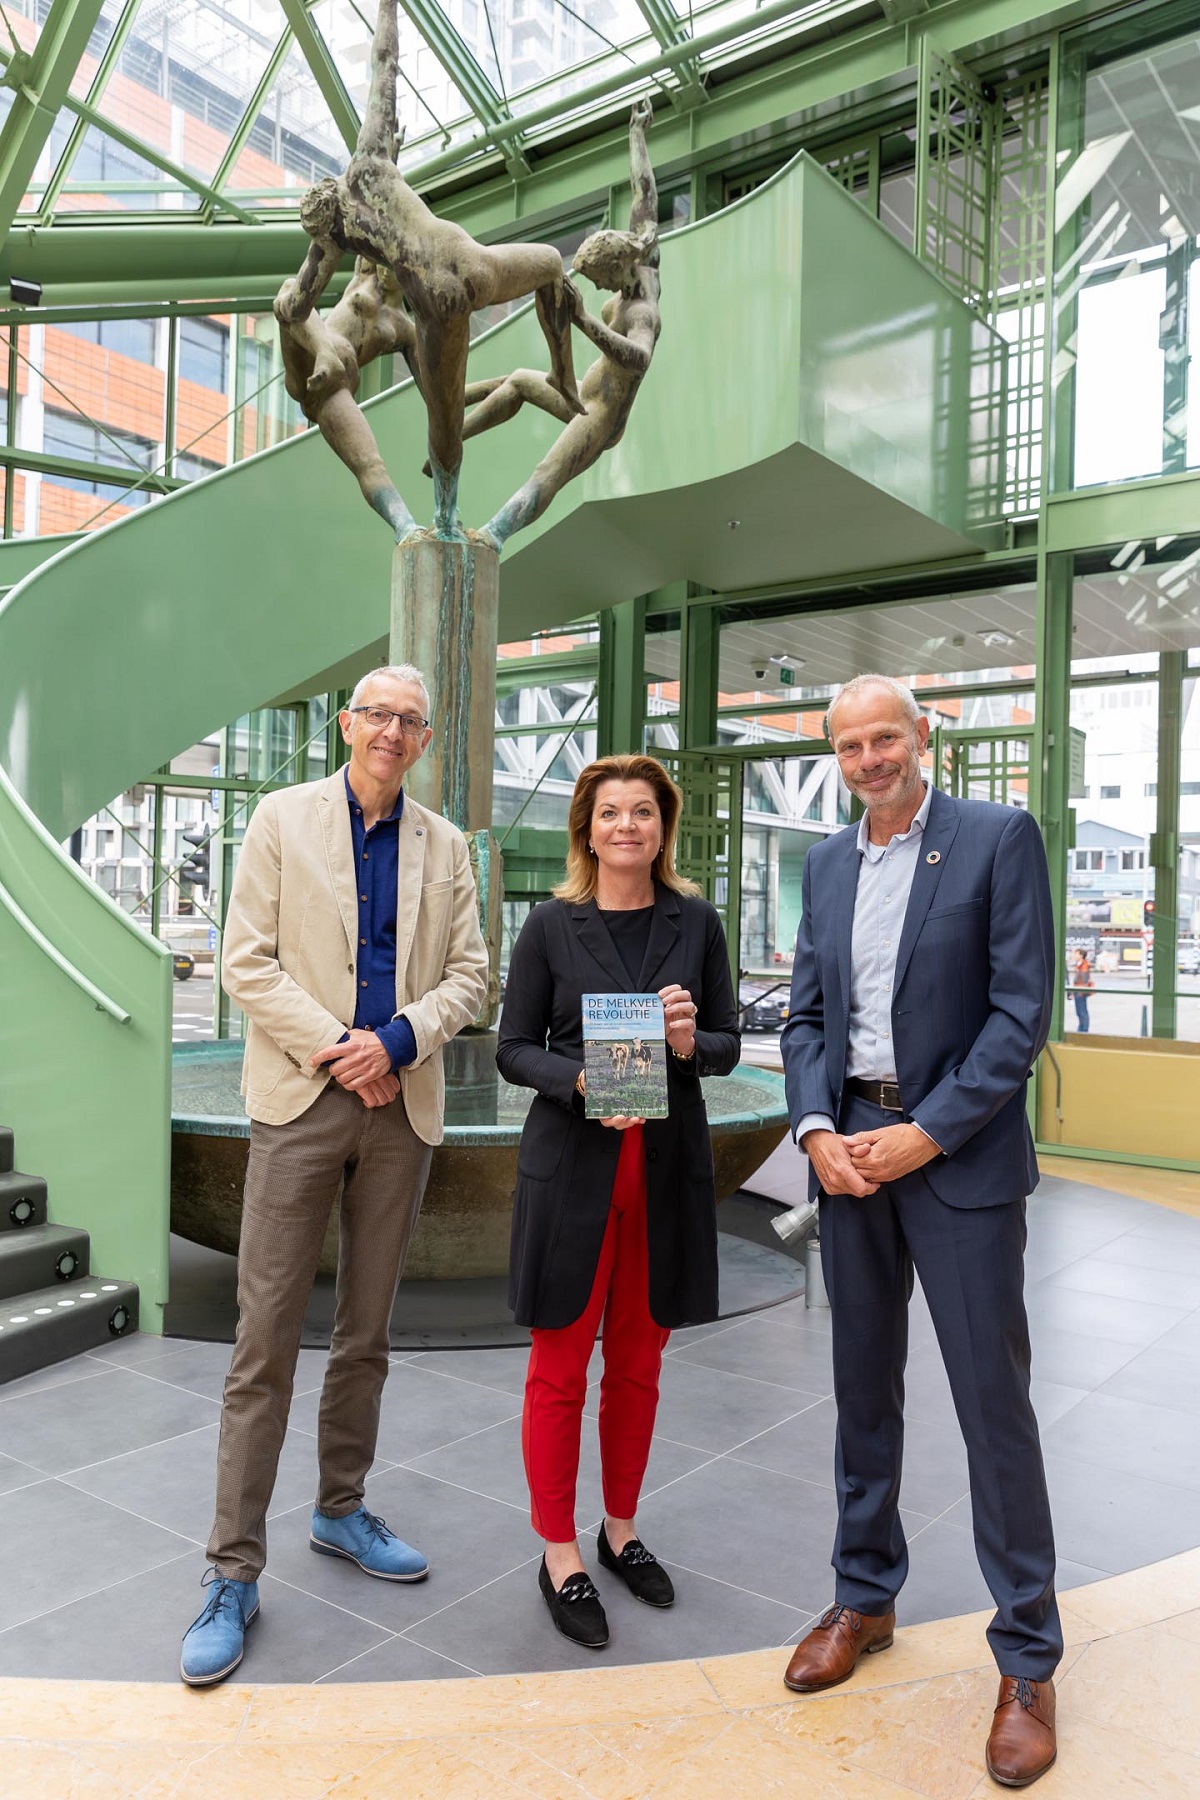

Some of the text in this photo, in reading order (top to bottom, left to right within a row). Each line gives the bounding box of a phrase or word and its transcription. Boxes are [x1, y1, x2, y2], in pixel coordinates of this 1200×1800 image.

[588, 998, 658, 1008] DE MELKVEE
[588, 1010, 650, 1019] REVOLUTIE
